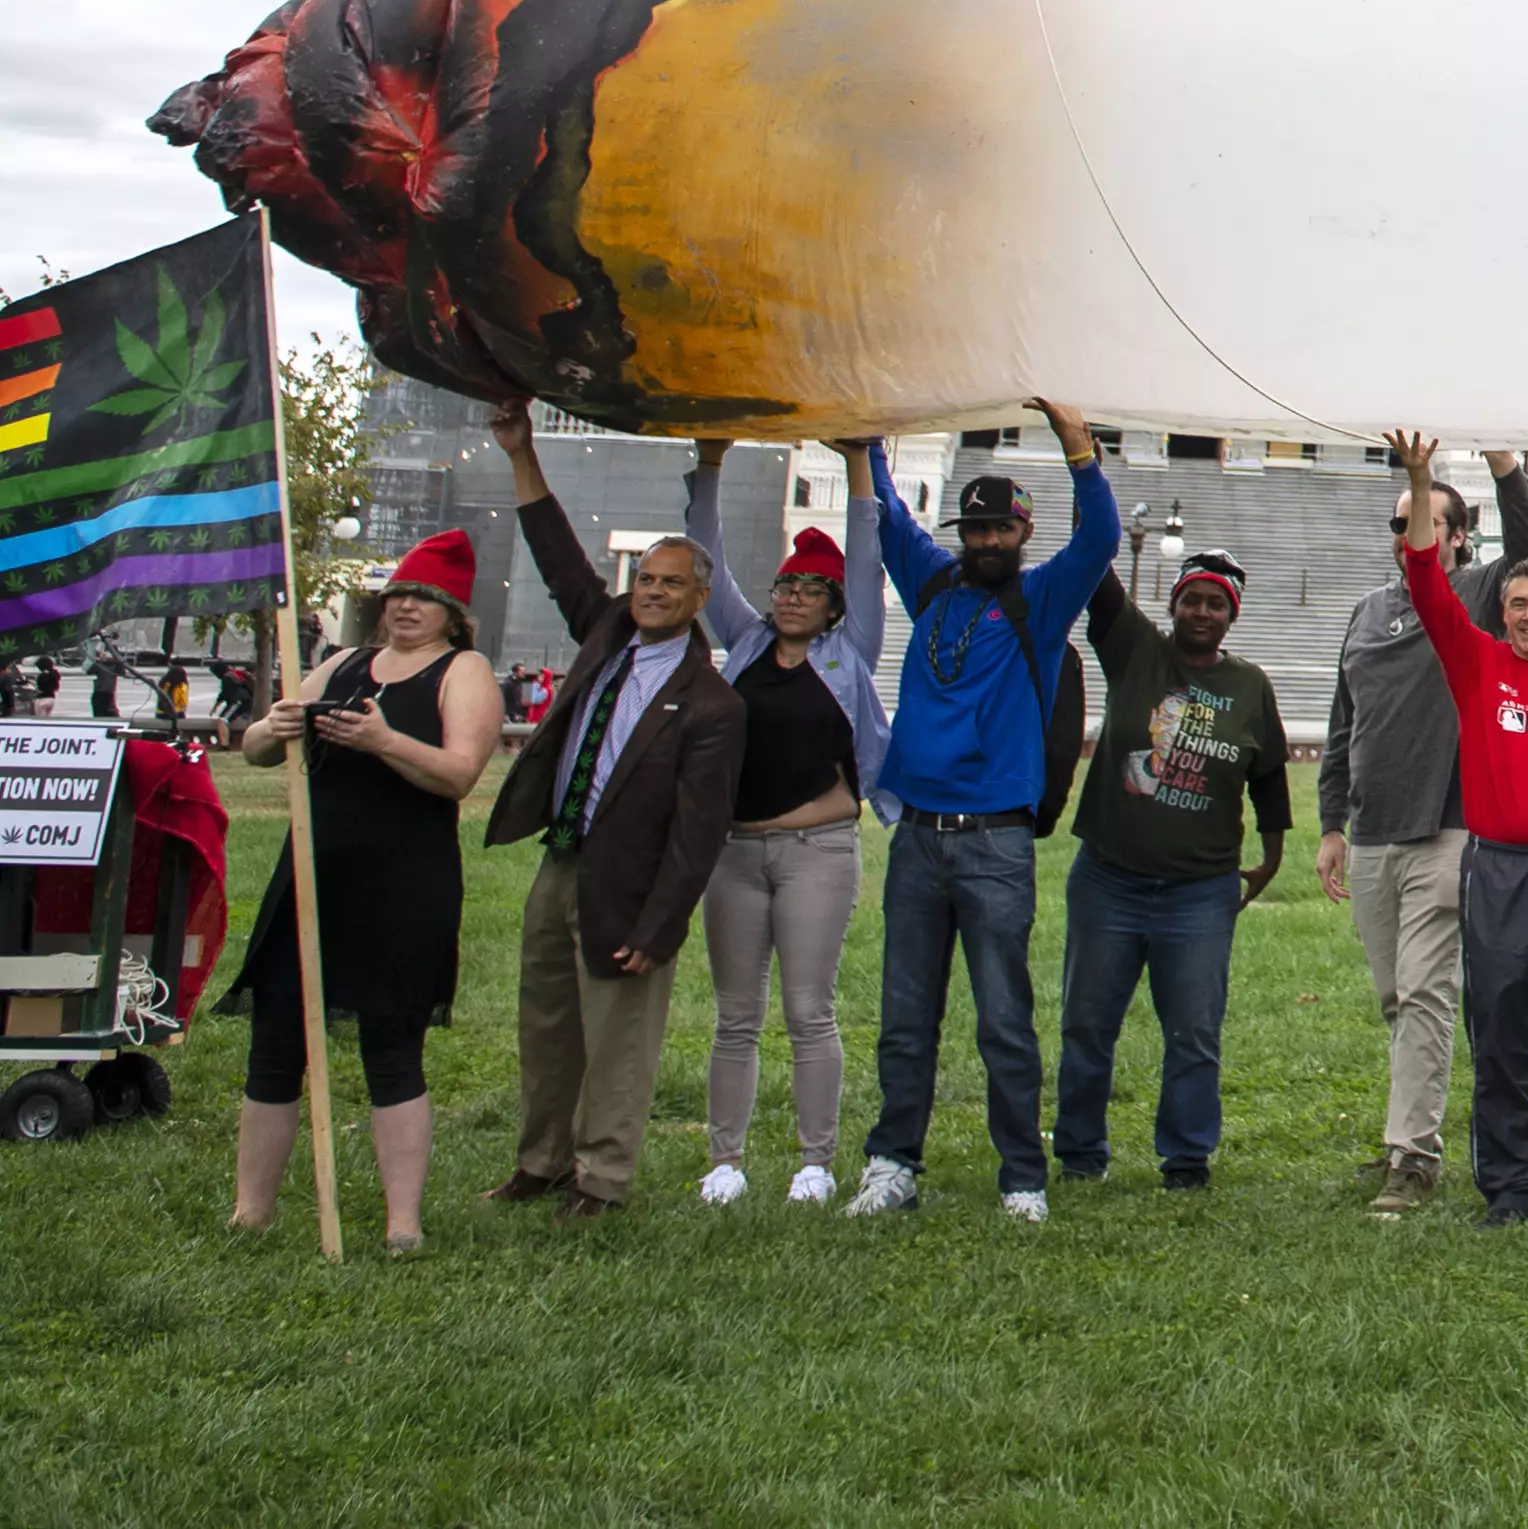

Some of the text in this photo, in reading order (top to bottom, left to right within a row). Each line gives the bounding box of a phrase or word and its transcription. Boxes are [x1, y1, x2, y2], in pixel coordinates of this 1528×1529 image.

[1188, 685, 1234, 711] FIGHT
[1186, 703, 1215, 721] FOR
[1181, 717, 1215, 737] THE
[34, 738, 97, 755] JOINT.
[1176, 731, 1240, 763] THINGS
[1170, 748, 1206, 773] YOU
[41, 777, 100, 801] NOW!
[1161, 767, 1209, 792] CARE
[1155, 785, 1214, 811] ABOUT
[25, 825, 82, 847] COMJ
